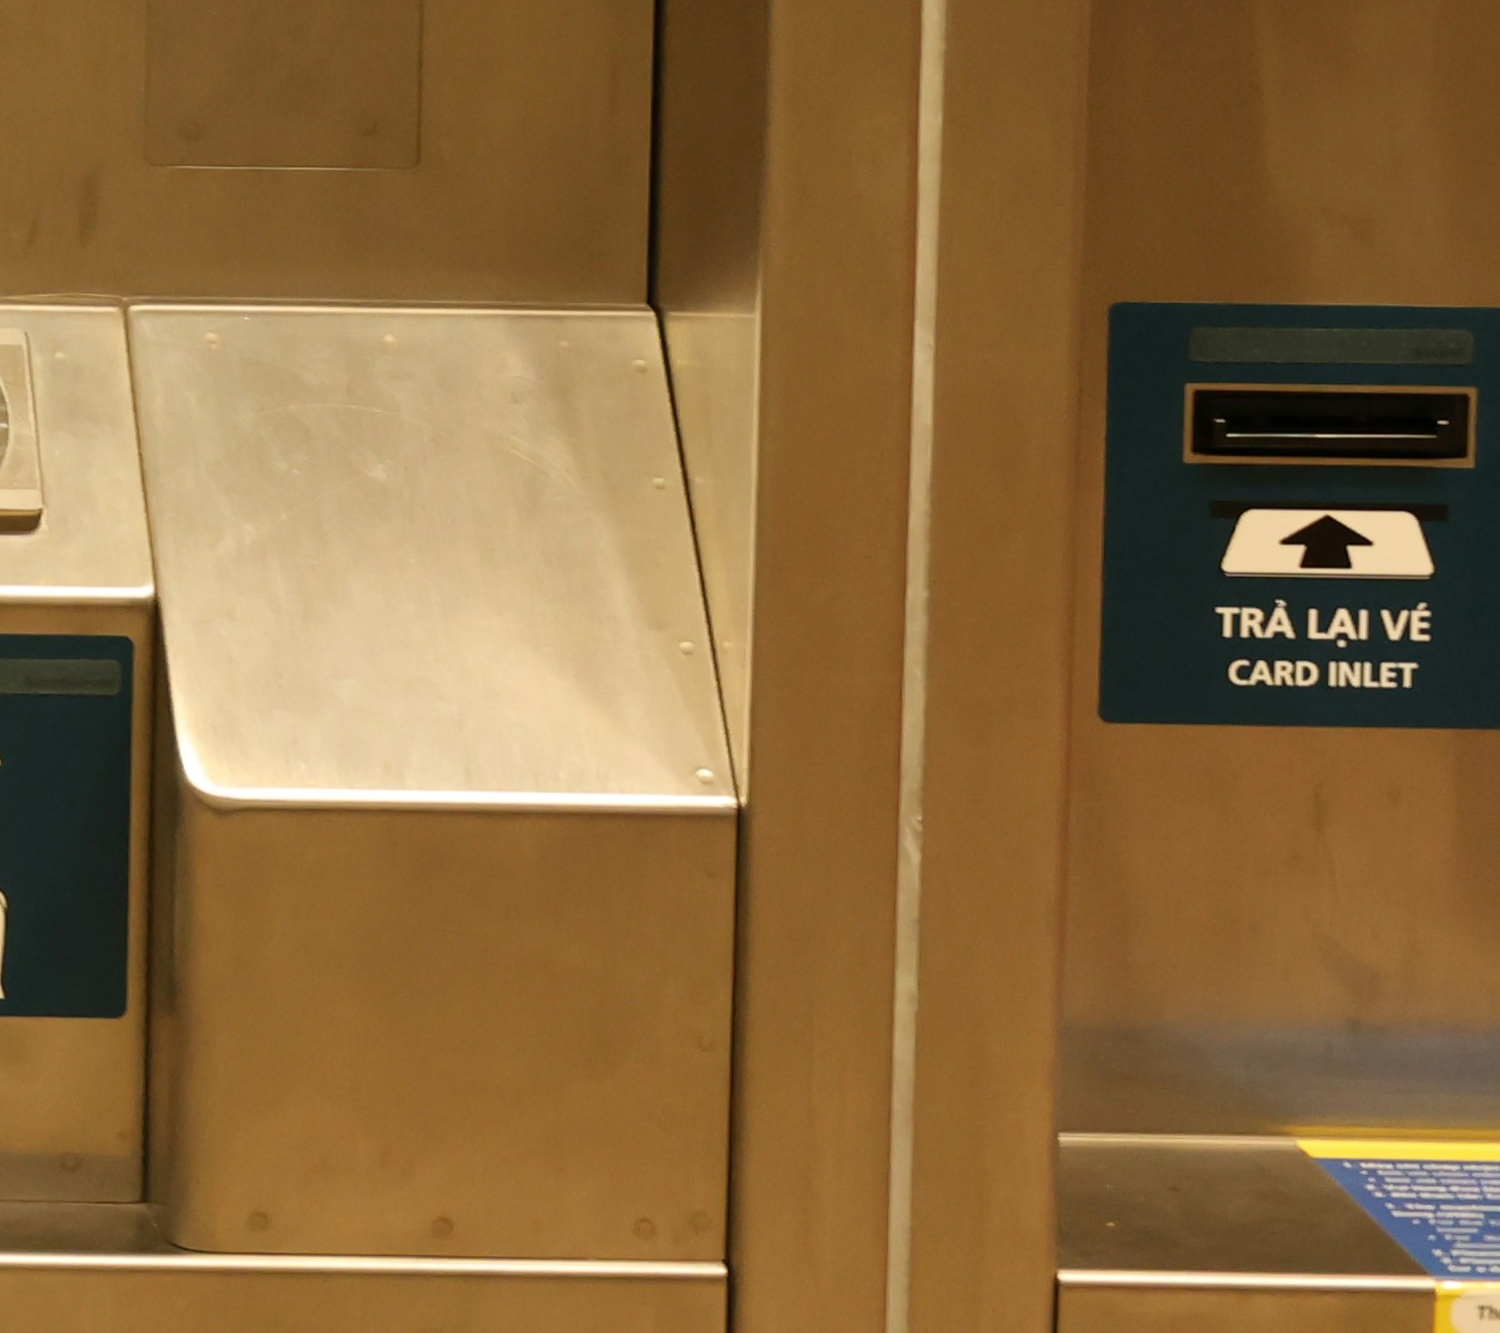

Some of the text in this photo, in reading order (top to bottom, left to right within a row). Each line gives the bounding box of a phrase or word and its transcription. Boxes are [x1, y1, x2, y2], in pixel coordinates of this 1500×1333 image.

[1215, 599, 1431, 648] TRẢ LẠI VÉ
[1228, 659, 1418, 688] CARD INLET
